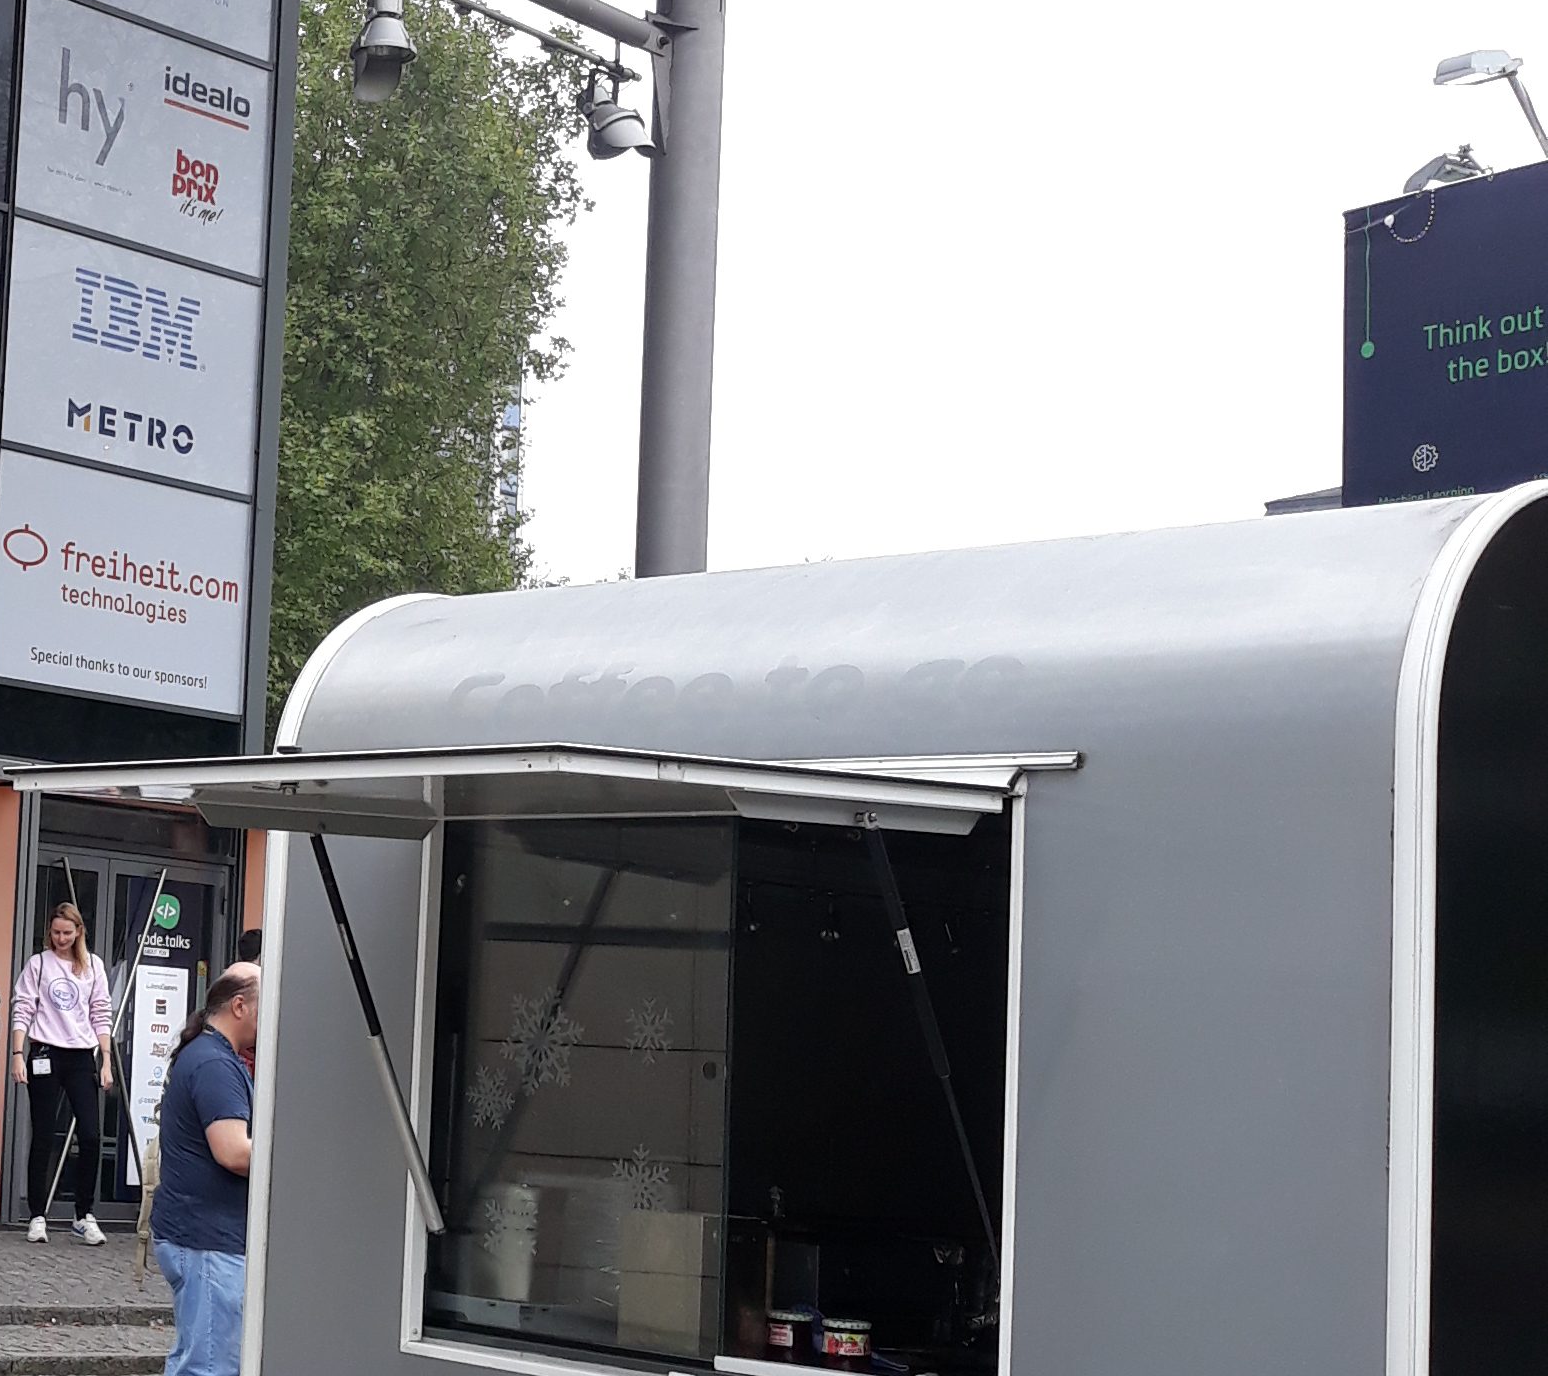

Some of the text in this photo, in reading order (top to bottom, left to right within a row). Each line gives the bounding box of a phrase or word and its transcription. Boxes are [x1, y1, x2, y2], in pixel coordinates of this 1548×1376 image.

[58, 46, 250, 167] hy idealo
[176, 148, 219, 185] bon
[171, 173, 217, 206] prix
[179, 198, 225, 226] it's me!
[72, 267, 201, 370] IBM
[1423, 305, 1544, 350] Think out
[1447, 356, 1489, 382] the
[68, 398, 194, 455] METRO
[60, 541, 239, 603] freiheit.com
[61, 583, 188, 624] technologies
[30, 646, 208, 689] Special thanks to our sponsors!
[151, 1024, 170, 1033] OTTO
